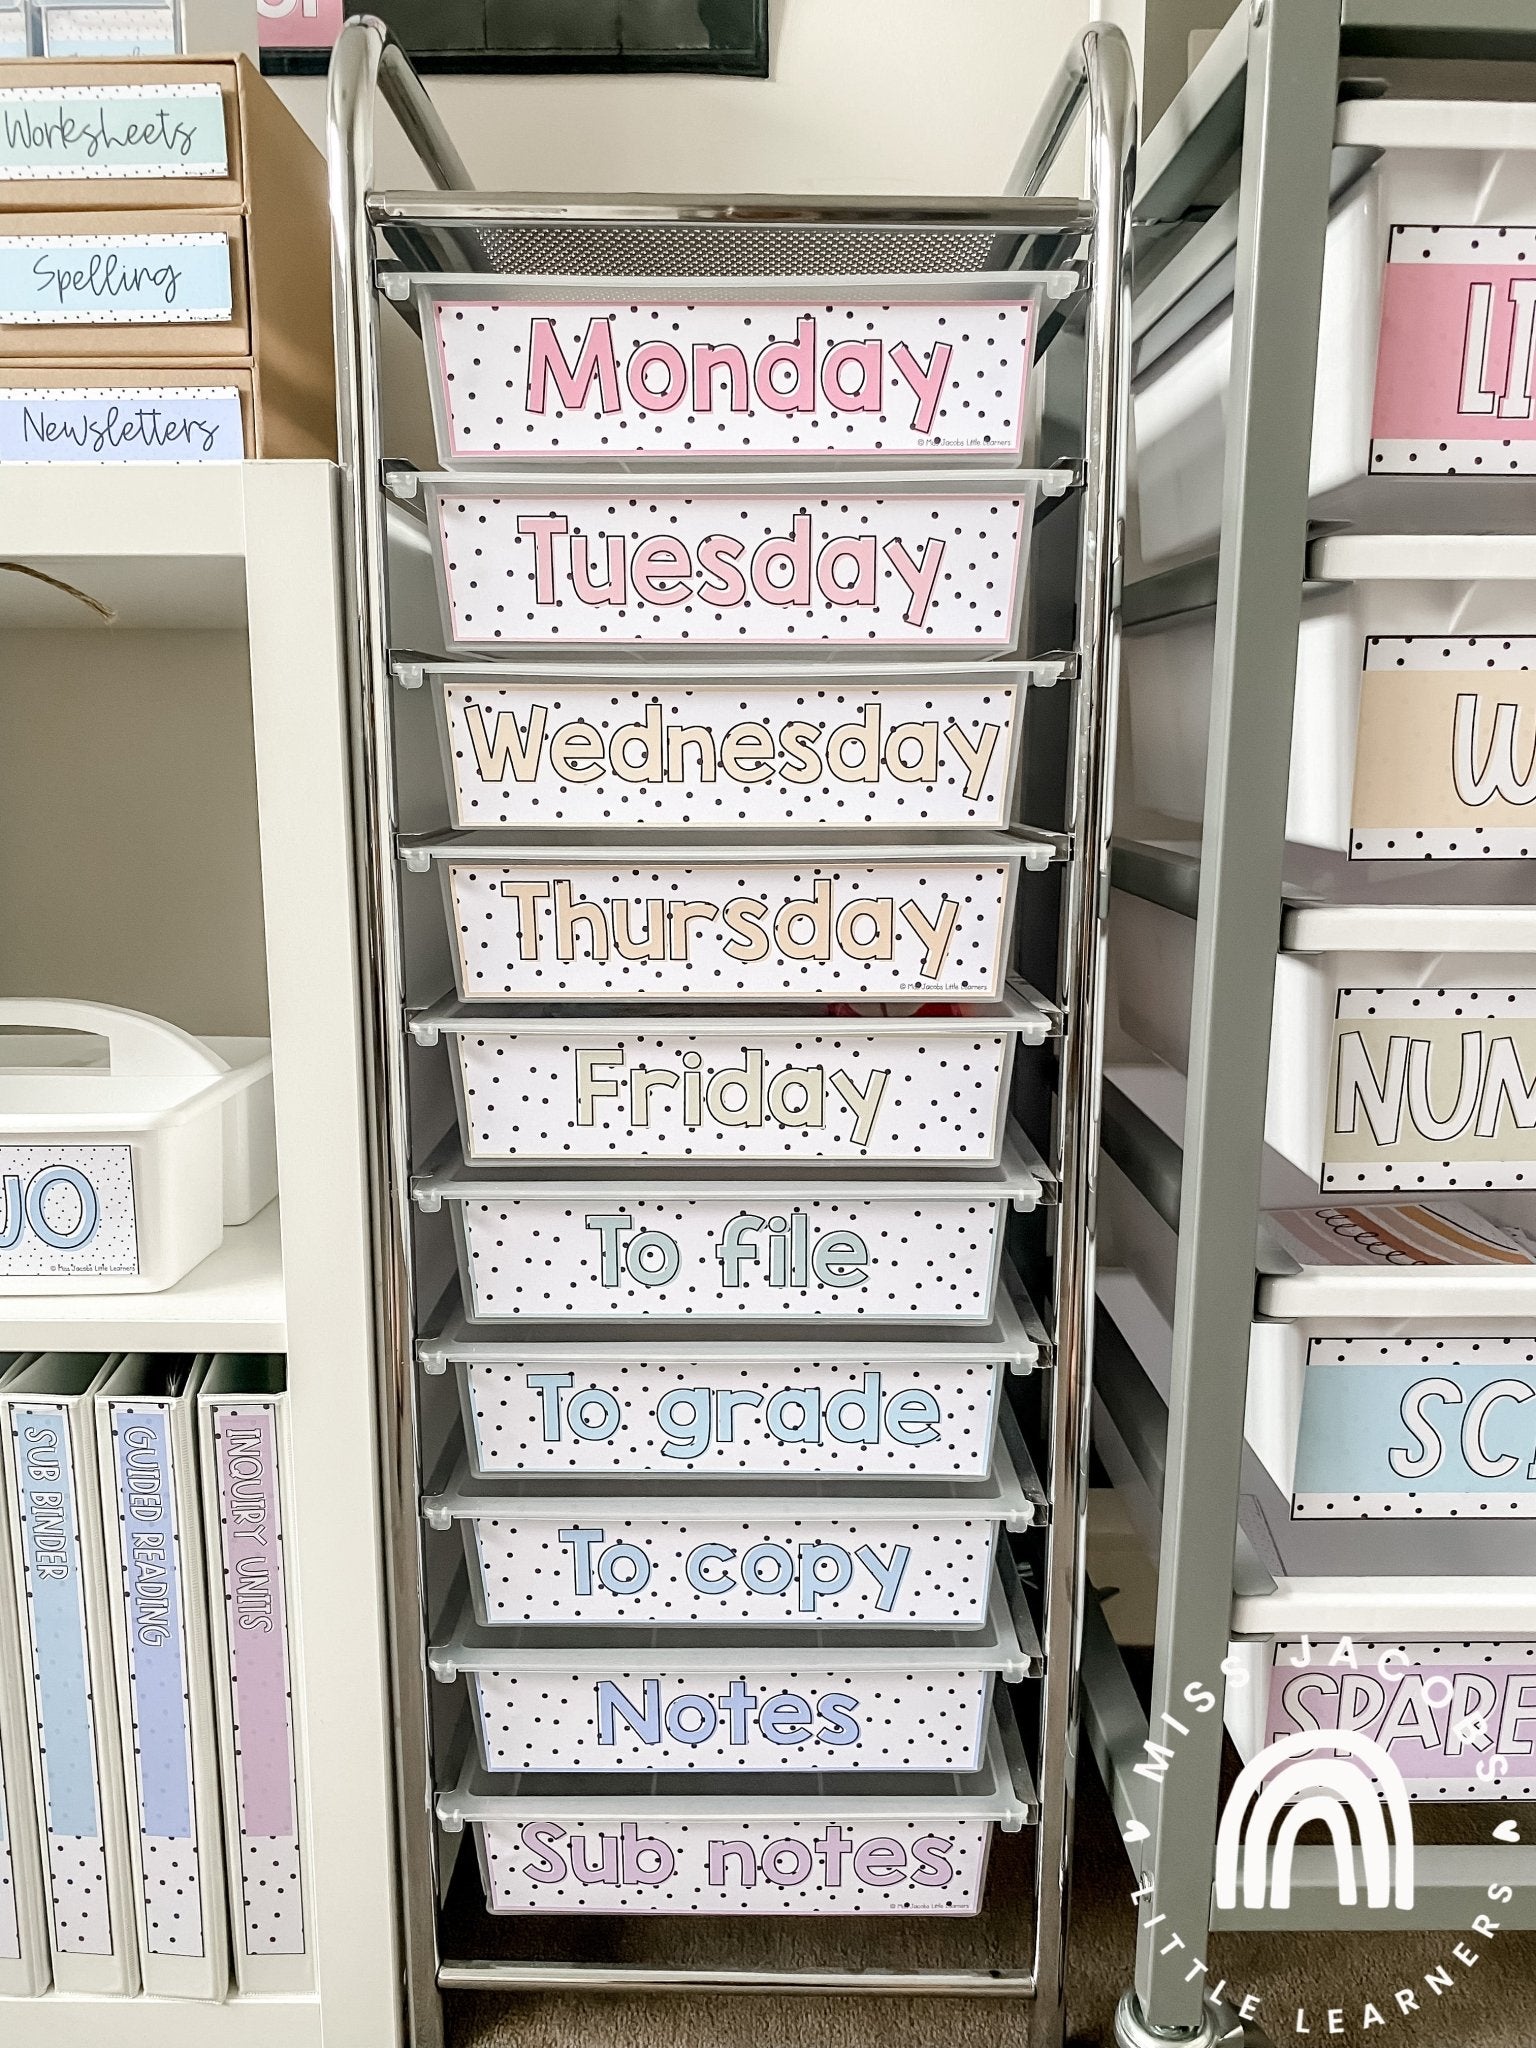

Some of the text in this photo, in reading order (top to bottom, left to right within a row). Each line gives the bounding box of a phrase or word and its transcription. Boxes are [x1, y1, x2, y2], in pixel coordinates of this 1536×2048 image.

[4, 106, 198, 158] Worksheets
[33, 254, 182, 303] Spelling
[525, 317, 952, 433] Monday
[23, 406, 219, 451] Newsletters
[941, 438, 964, 447] Jacobs
[966, 438, 981, 446] Little
[517, 514, 945, 626] Tuesday
[464, 703, 1000, 800] Wednesday
[501, 879, 959, 979] Thursday
[922, 982, 943, 991] Jacobs
[945, 982, 958, 990] Little
[575, 1048, 890, 1146] Friday
[585, 1212, 870, 1289] To file
[527, 1372, 941, 1459] To grade
[24, 1426, 69, 1581] SUB BINDER
[123, 1426, 170, 1648] GUIDED READING
[225, 1428, 273, 1634] INQUIRY UNITS
[558, 1528, 911, 1612] To copy
[597, 1679, 861, 1746] Notes
[521, 1821, 954, 1887] Sub notes
